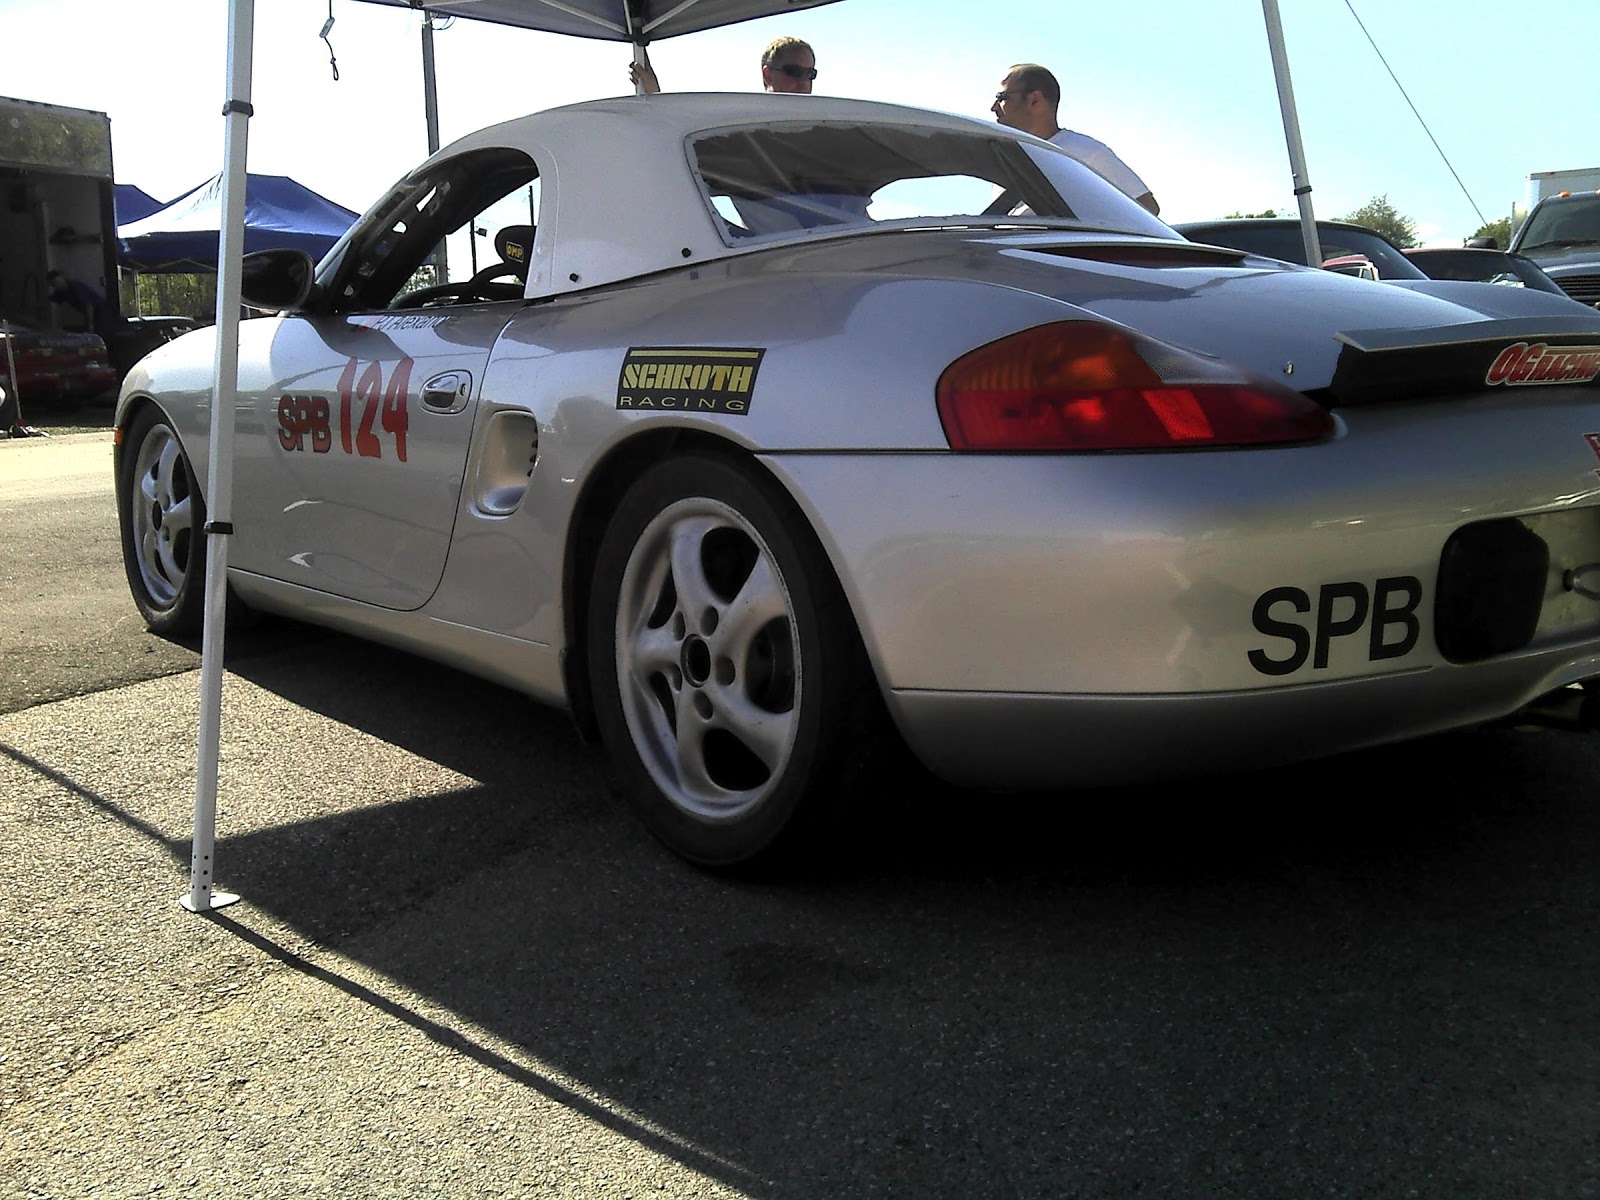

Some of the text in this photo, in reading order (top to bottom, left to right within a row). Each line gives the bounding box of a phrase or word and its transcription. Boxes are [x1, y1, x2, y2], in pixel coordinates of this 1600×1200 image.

[506, 244, 523, 258] OMP
[622, 363, 754, 393] SCHROTH
[278, 356, 414, 463] SPB 124
[620, 396, 745, 411] RACING
[1247, 575, 1423, 676] SPB
